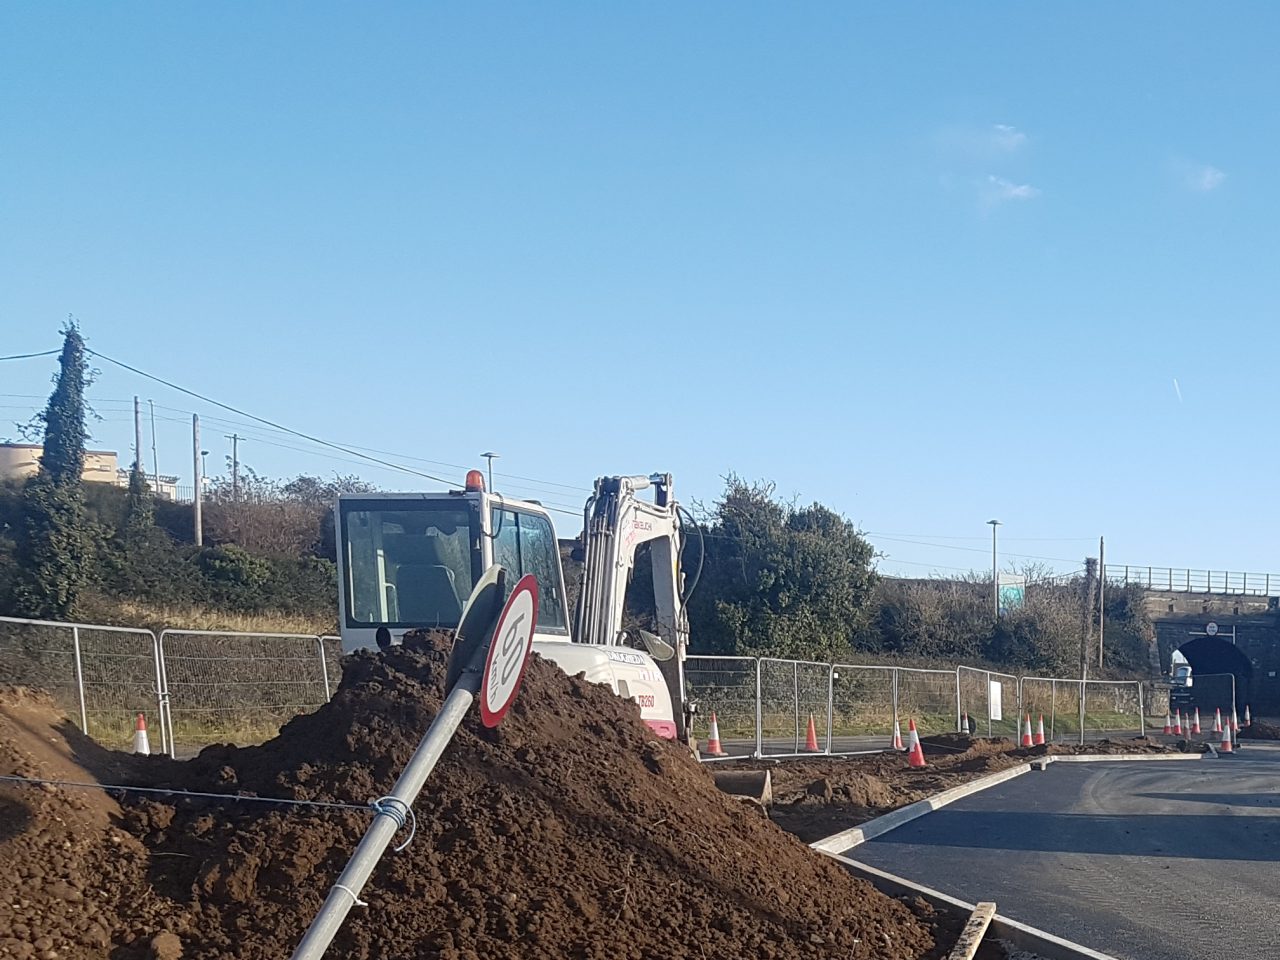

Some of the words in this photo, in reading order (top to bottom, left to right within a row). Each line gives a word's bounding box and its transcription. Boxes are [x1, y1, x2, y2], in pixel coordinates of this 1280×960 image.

[502, 613, 525, 685] 60
[490, 652, 500, 704] km/h
[638, 695, 655, 707] TB260
